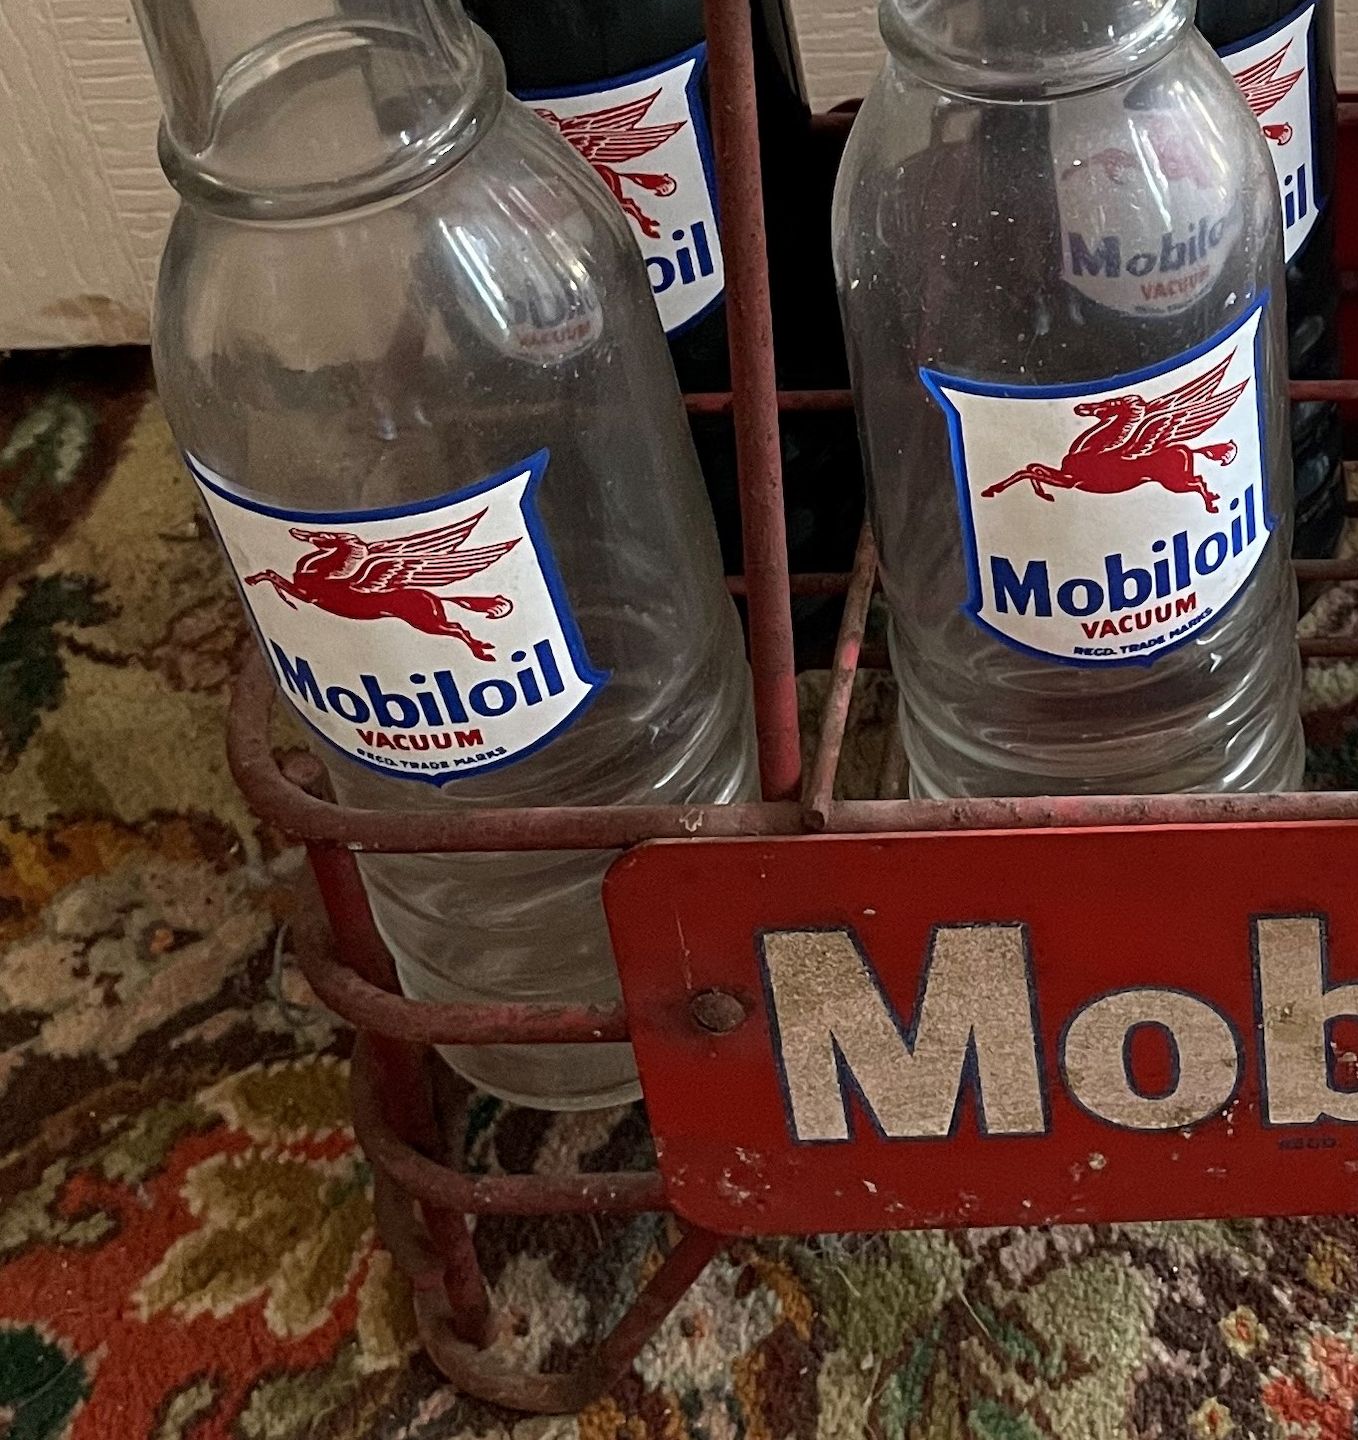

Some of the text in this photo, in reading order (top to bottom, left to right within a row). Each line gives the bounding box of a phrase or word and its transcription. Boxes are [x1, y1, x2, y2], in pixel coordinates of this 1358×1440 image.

[990, 484, 1256, 617] Mobiloil
[1081, 592, 1197, 639] VACUUM
[1120, 634, 1166, 654] TRADE
[269, 639, 565, 729] Mobiloil
[356, 728, 484, 751] VACUUM
[400, 760, 450, 770] TRADE
